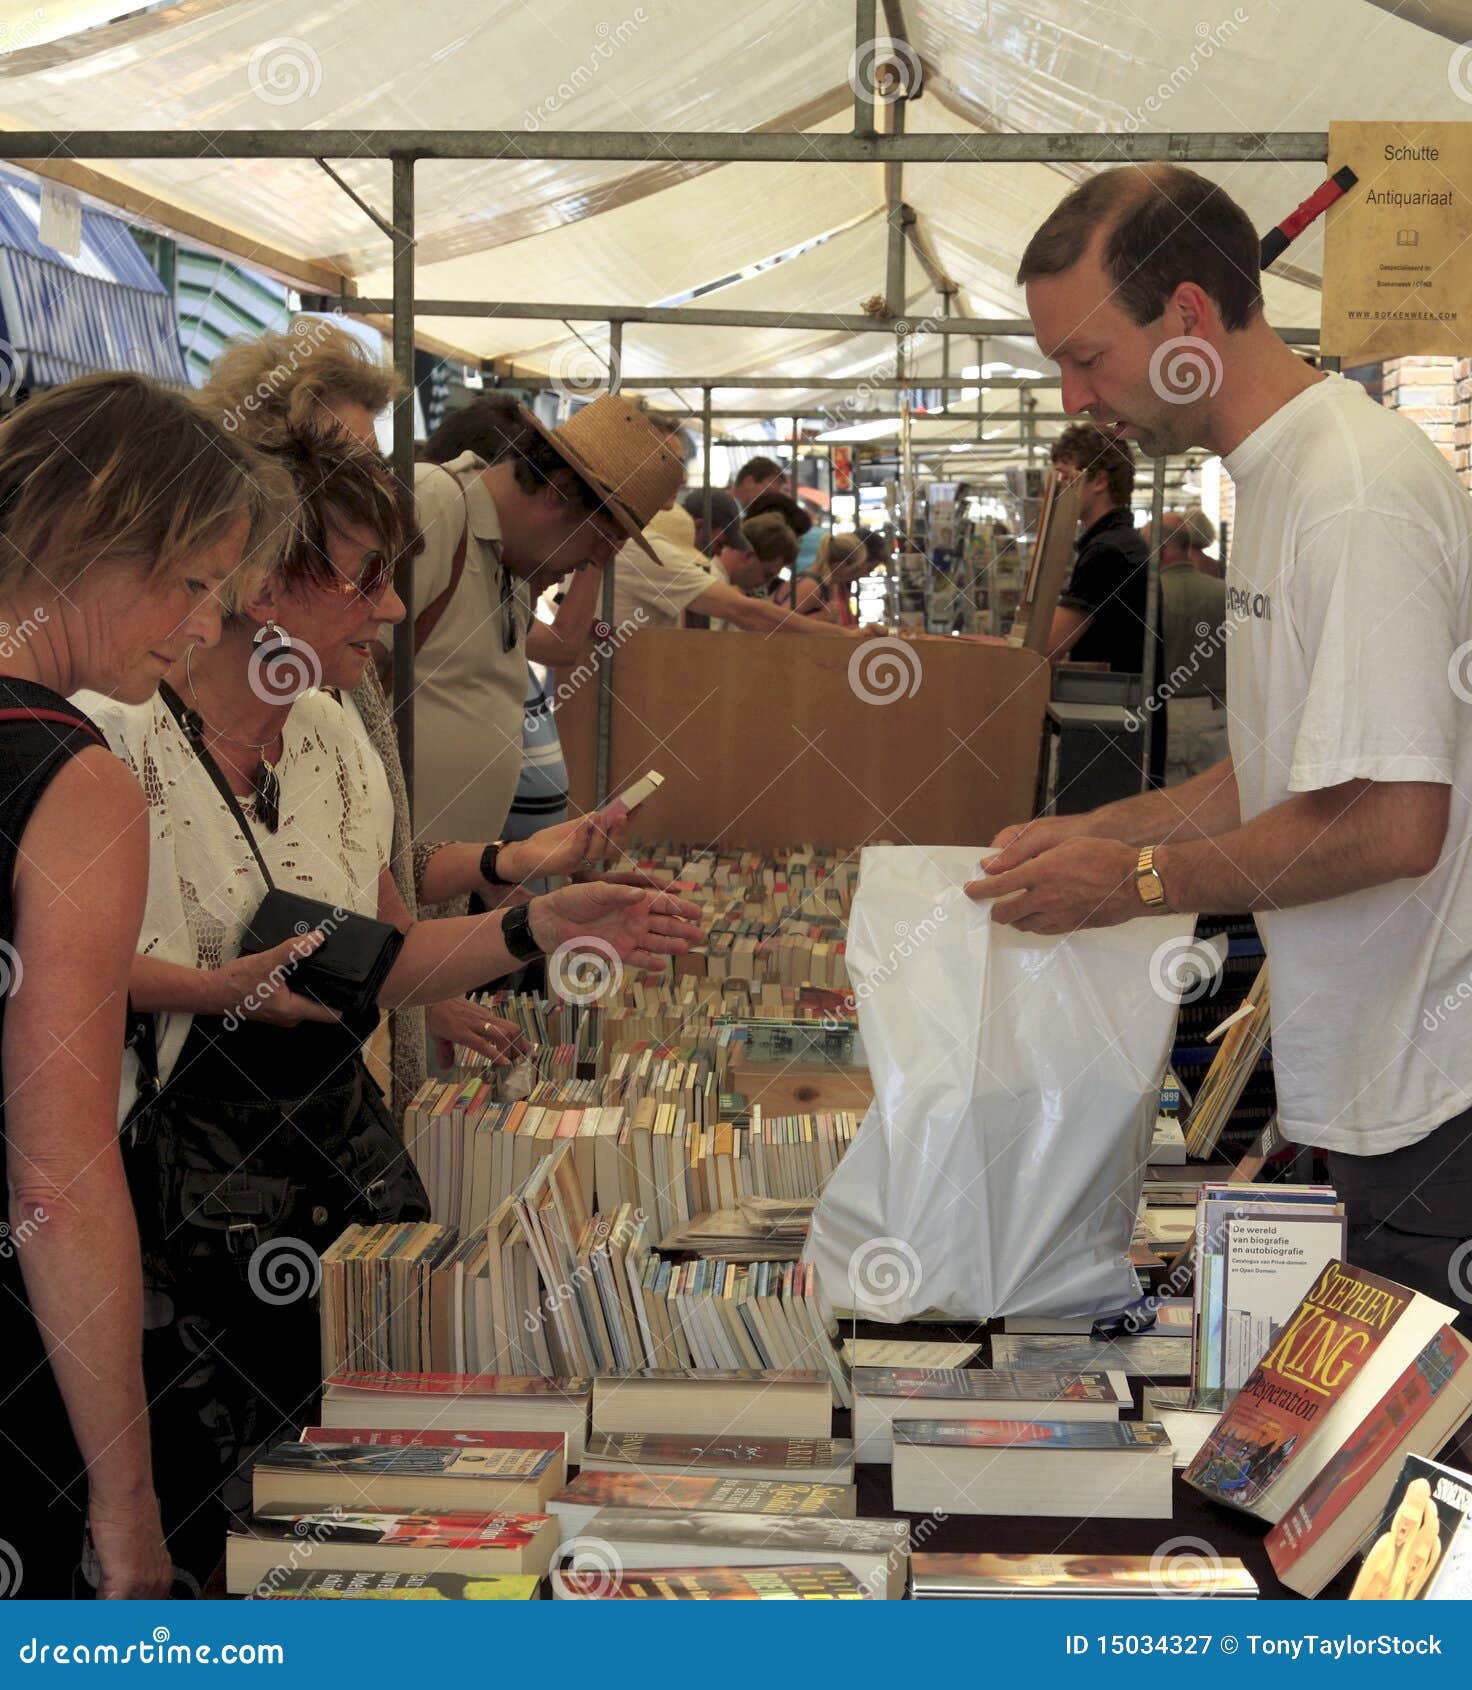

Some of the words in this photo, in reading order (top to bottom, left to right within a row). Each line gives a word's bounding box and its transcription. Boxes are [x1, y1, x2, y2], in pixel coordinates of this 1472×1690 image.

[1384, 145, 1439, 161] Schutte
[1366, 189, 1453, 208] Antiquariaat
[1250, 1236, 1289, 1245] biografie
[1245, 1247, 1304, 1256] autobiografie
[1309, 1263, 1404, 1330] STEPHEN
[1260, 1302, 1370, 1387] KING
[1245, 1369, 1319, 1422] Desperation
